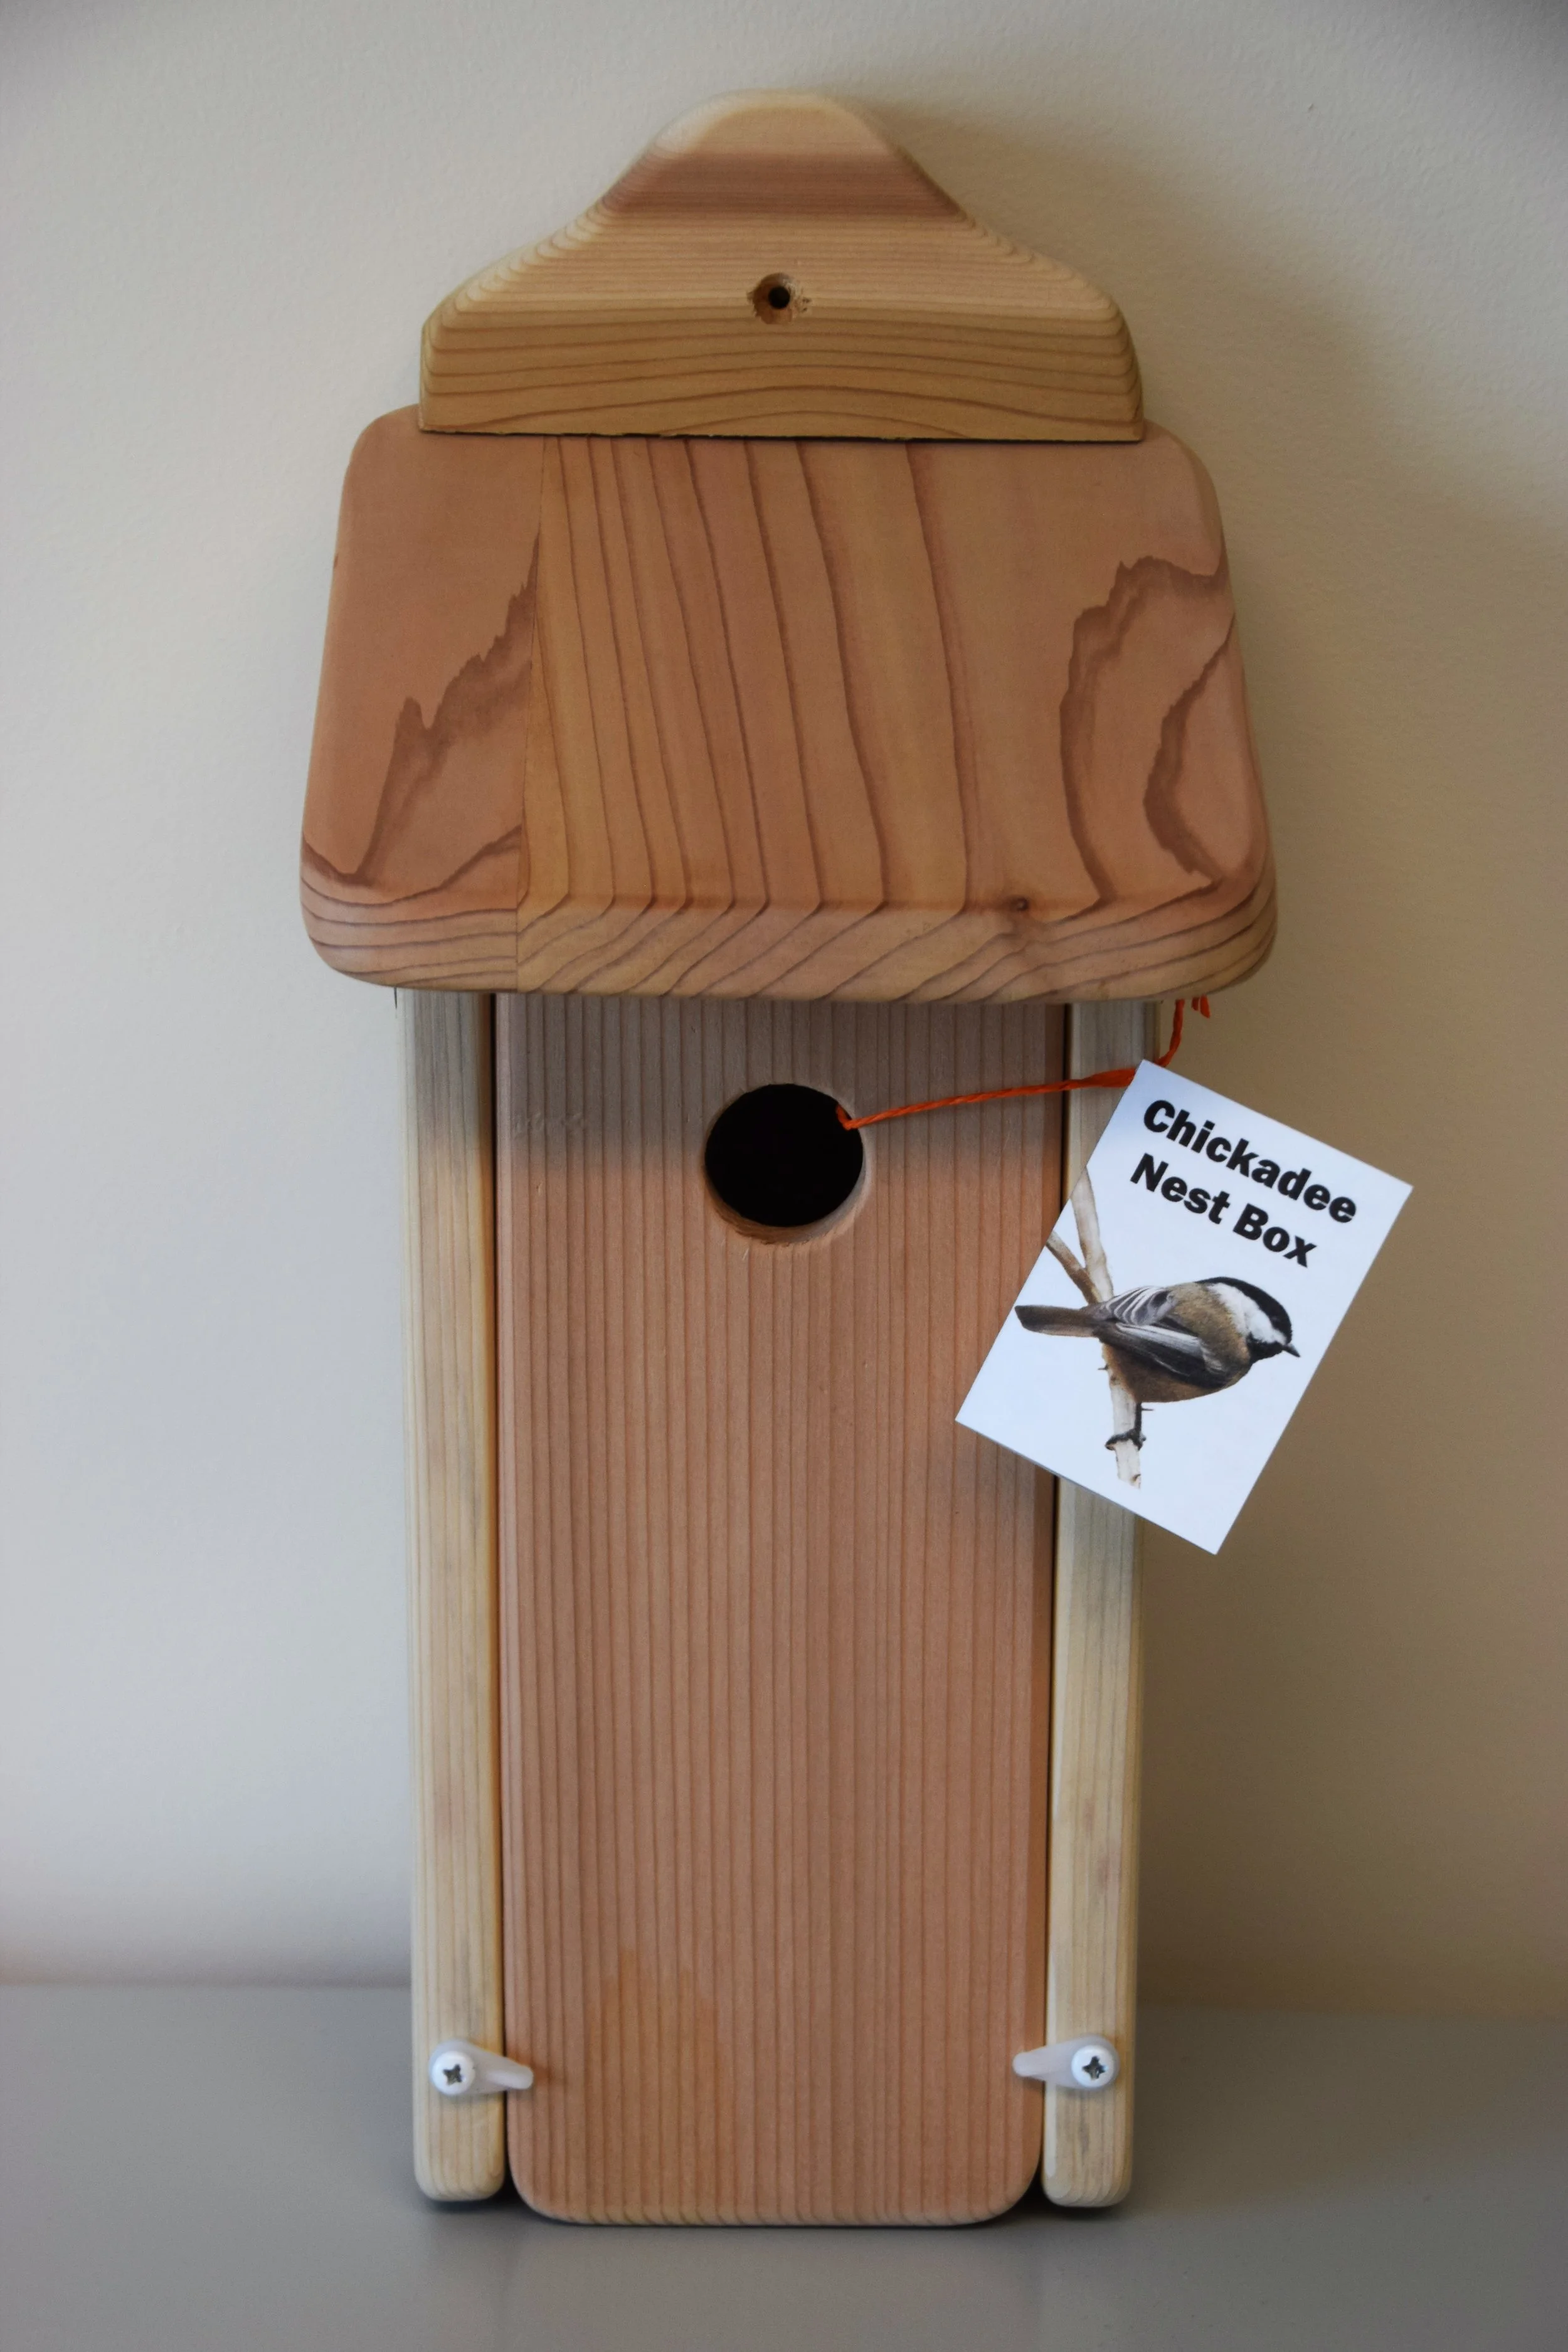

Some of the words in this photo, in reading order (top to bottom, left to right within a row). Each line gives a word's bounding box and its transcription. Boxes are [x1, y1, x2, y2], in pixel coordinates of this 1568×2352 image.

[1130, 1153, 1231, 1224] Nest
[1232, 1203, 1316, 1268] Box
[1143, 1099, 1356, 1223] Chickadee
